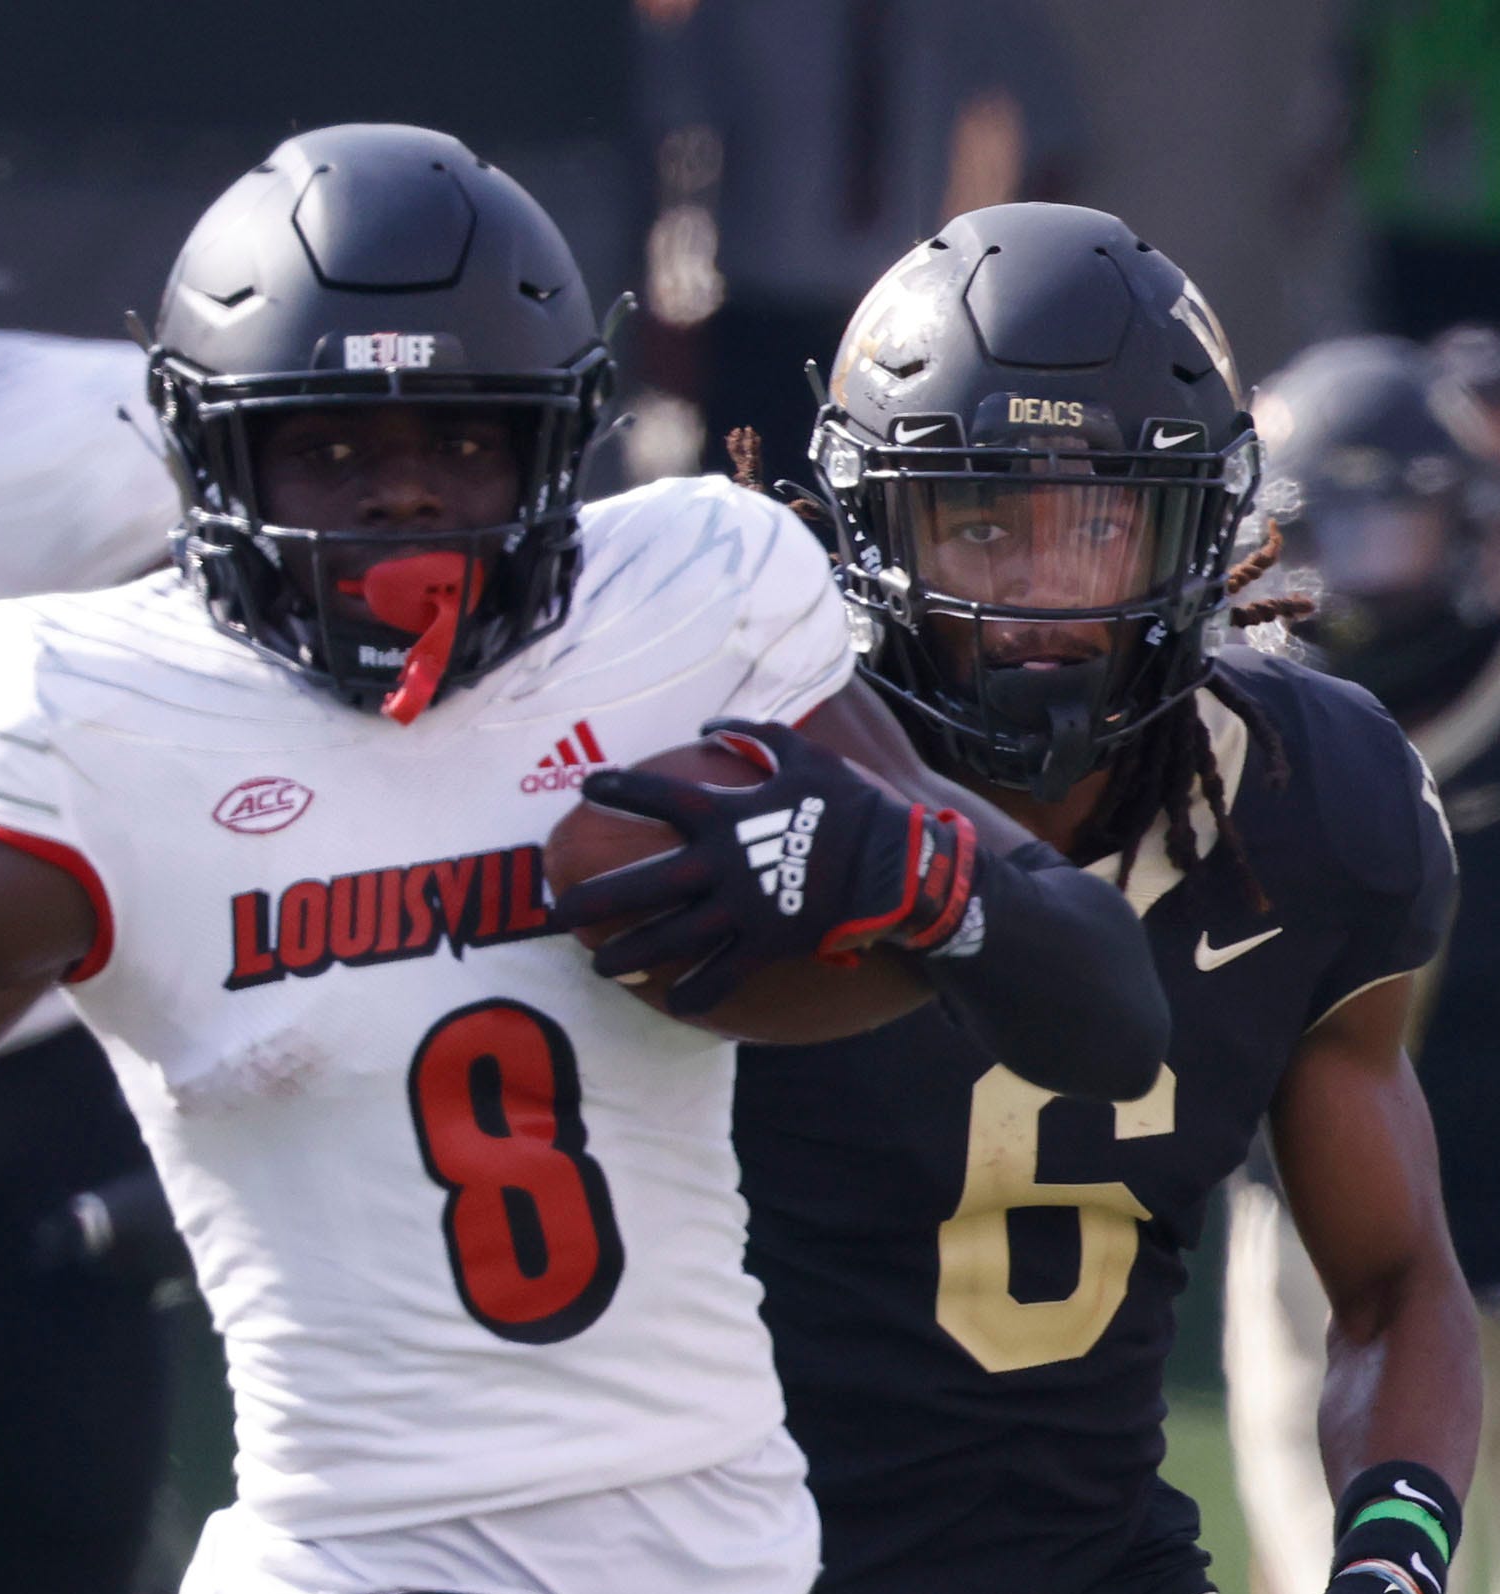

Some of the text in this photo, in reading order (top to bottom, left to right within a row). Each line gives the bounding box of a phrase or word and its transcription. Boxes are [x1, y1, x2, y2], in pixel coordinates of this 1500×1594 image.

[1008, 397, 1084, 427] DEACS
[229, 784, 296, 818] ACC
[778, 796, 826, 917] adidas
[222, 843, 562, 992] LOUISVIL
[407, 996, 625, 1345] 8
[935, 1060, 1177, 1375] 6
